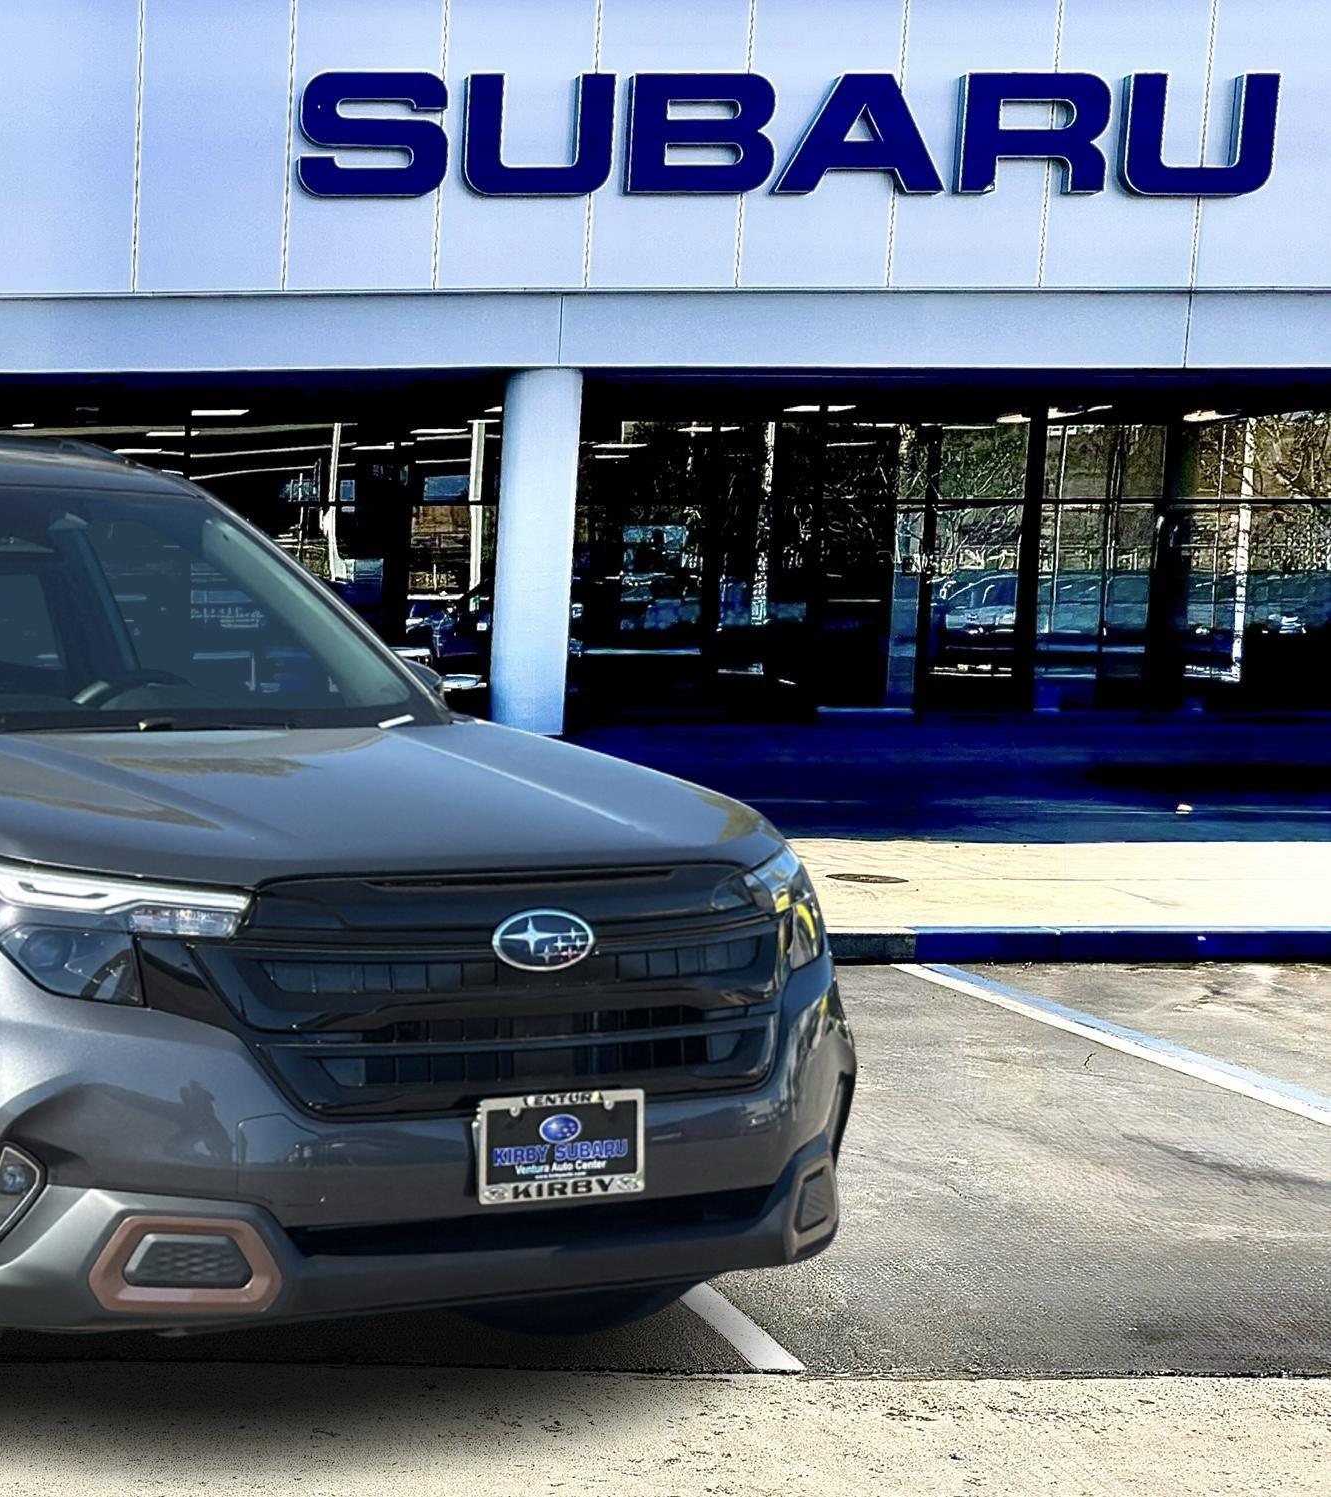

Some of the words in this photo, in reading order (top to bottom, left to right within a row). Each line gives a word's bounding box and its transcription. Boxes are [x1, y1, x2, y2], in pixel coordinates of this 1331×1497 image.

[296, 71, 1281, 198] SUBARU
[493, 1145, 551, 1166] KIRBY
[554, 1139, 628, 1161] SUBARU
[515, 1165, 549, 1175] Ventura
[551, 1162, 573, 1172] Auto
[575, 1160, 606, 1170] Center
[512, 1177, 615, 1200] KIRBY
